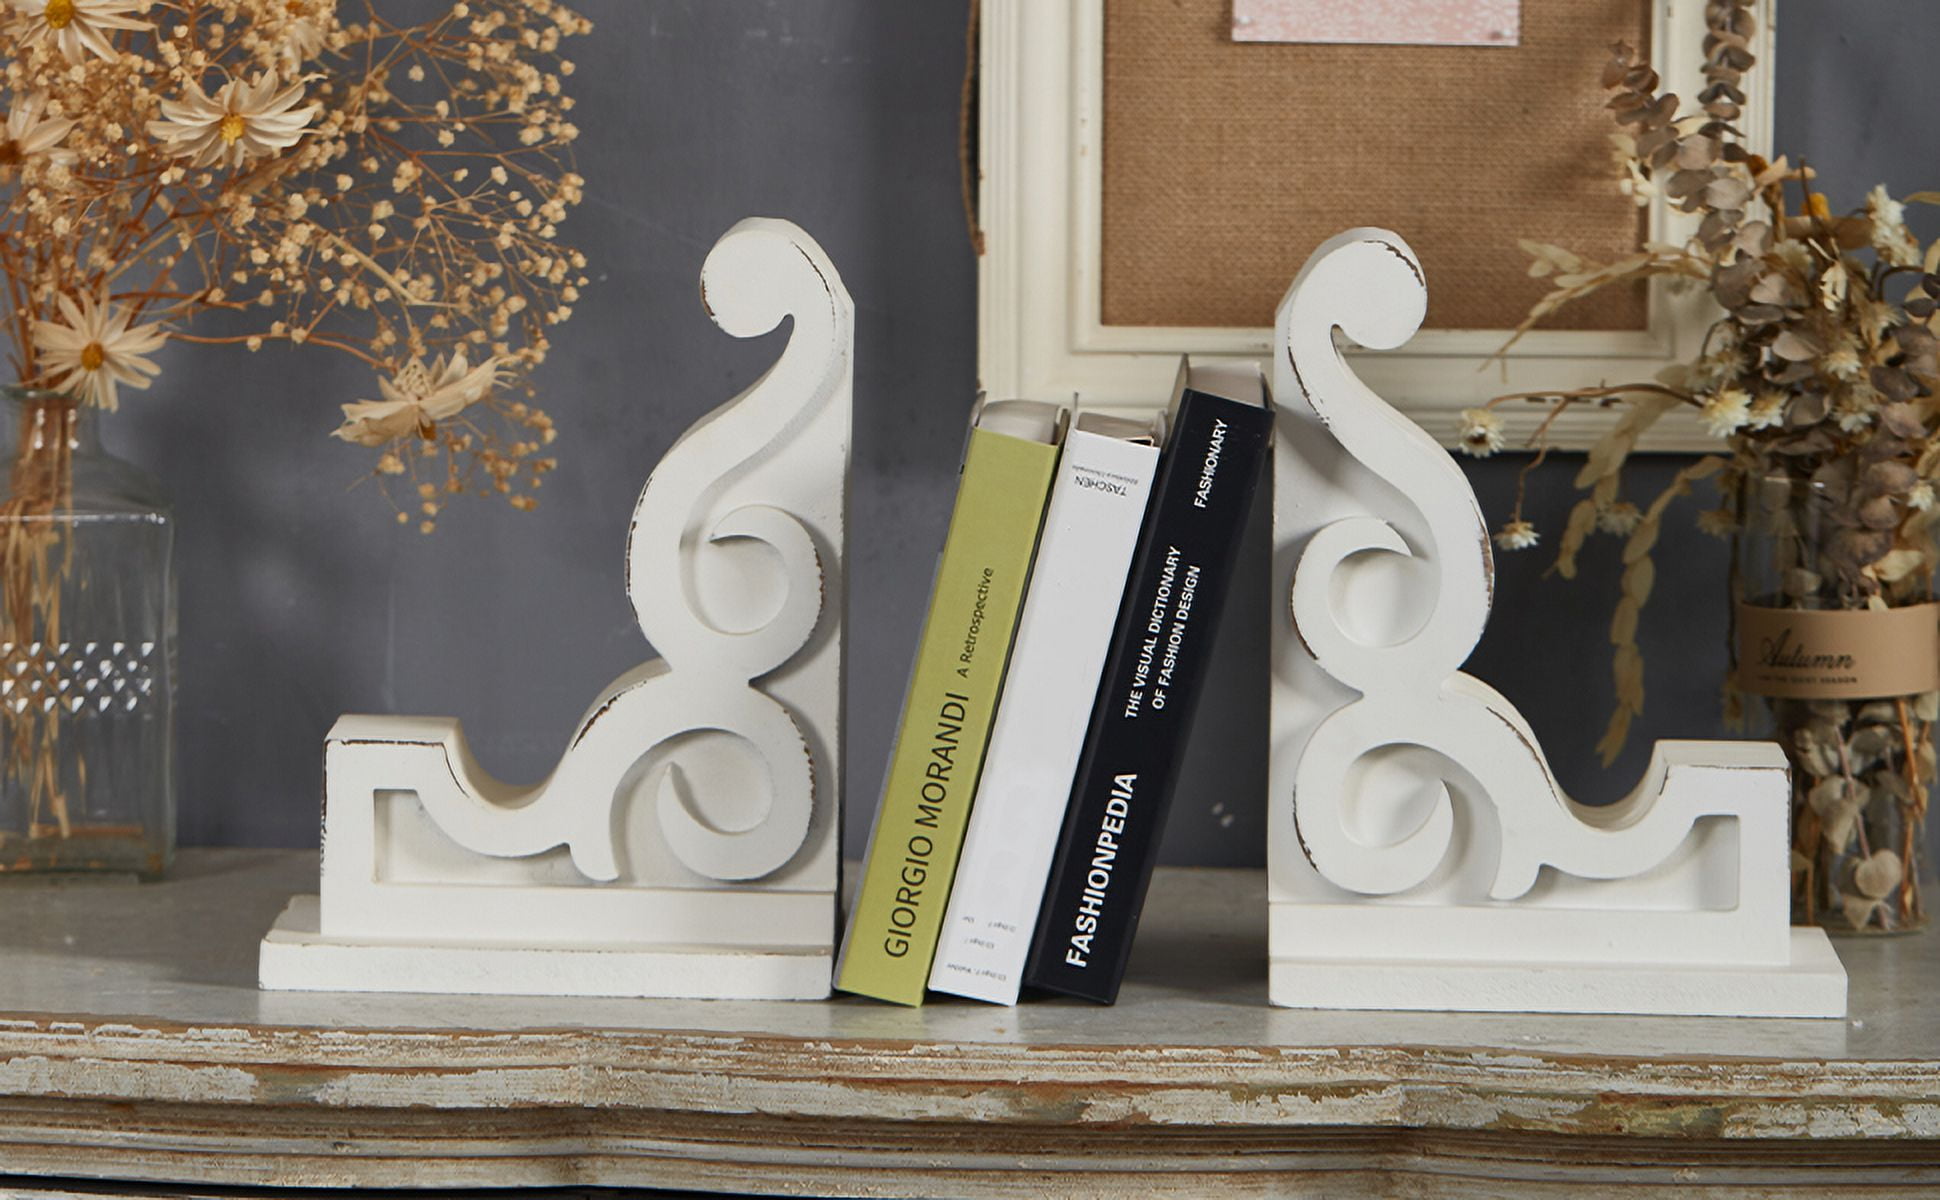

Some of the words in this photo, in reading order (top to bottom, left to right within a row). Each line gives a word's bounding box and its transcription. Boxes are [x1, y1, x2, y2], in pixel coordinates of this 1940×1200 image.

[1074, 476, 1127, 497] TASCHEN
[1194, 418, 1228, 508] FASHIONARY
[960, 567, 994, 664] Retrospective
[1148, 546, 1181, 633] DICTIONARY
[1176, 566, 1201, 621] DESIGN
[958, 666, 970, 679] A
[1133, 632, 1158, 687] VISUAL
[1158, 623, 1186, 687] FASHION
[1758, 627, 1855, 670] Autumn
[1125, 690, 1143, 718] THE
[1152, 688, 1166, 710] OF
[884, 835, 934, 958] GIORGIO
[915, 692, 969, 829] MORANDI
[1066, 773, 1138, 968] FASHIONPEDIA
